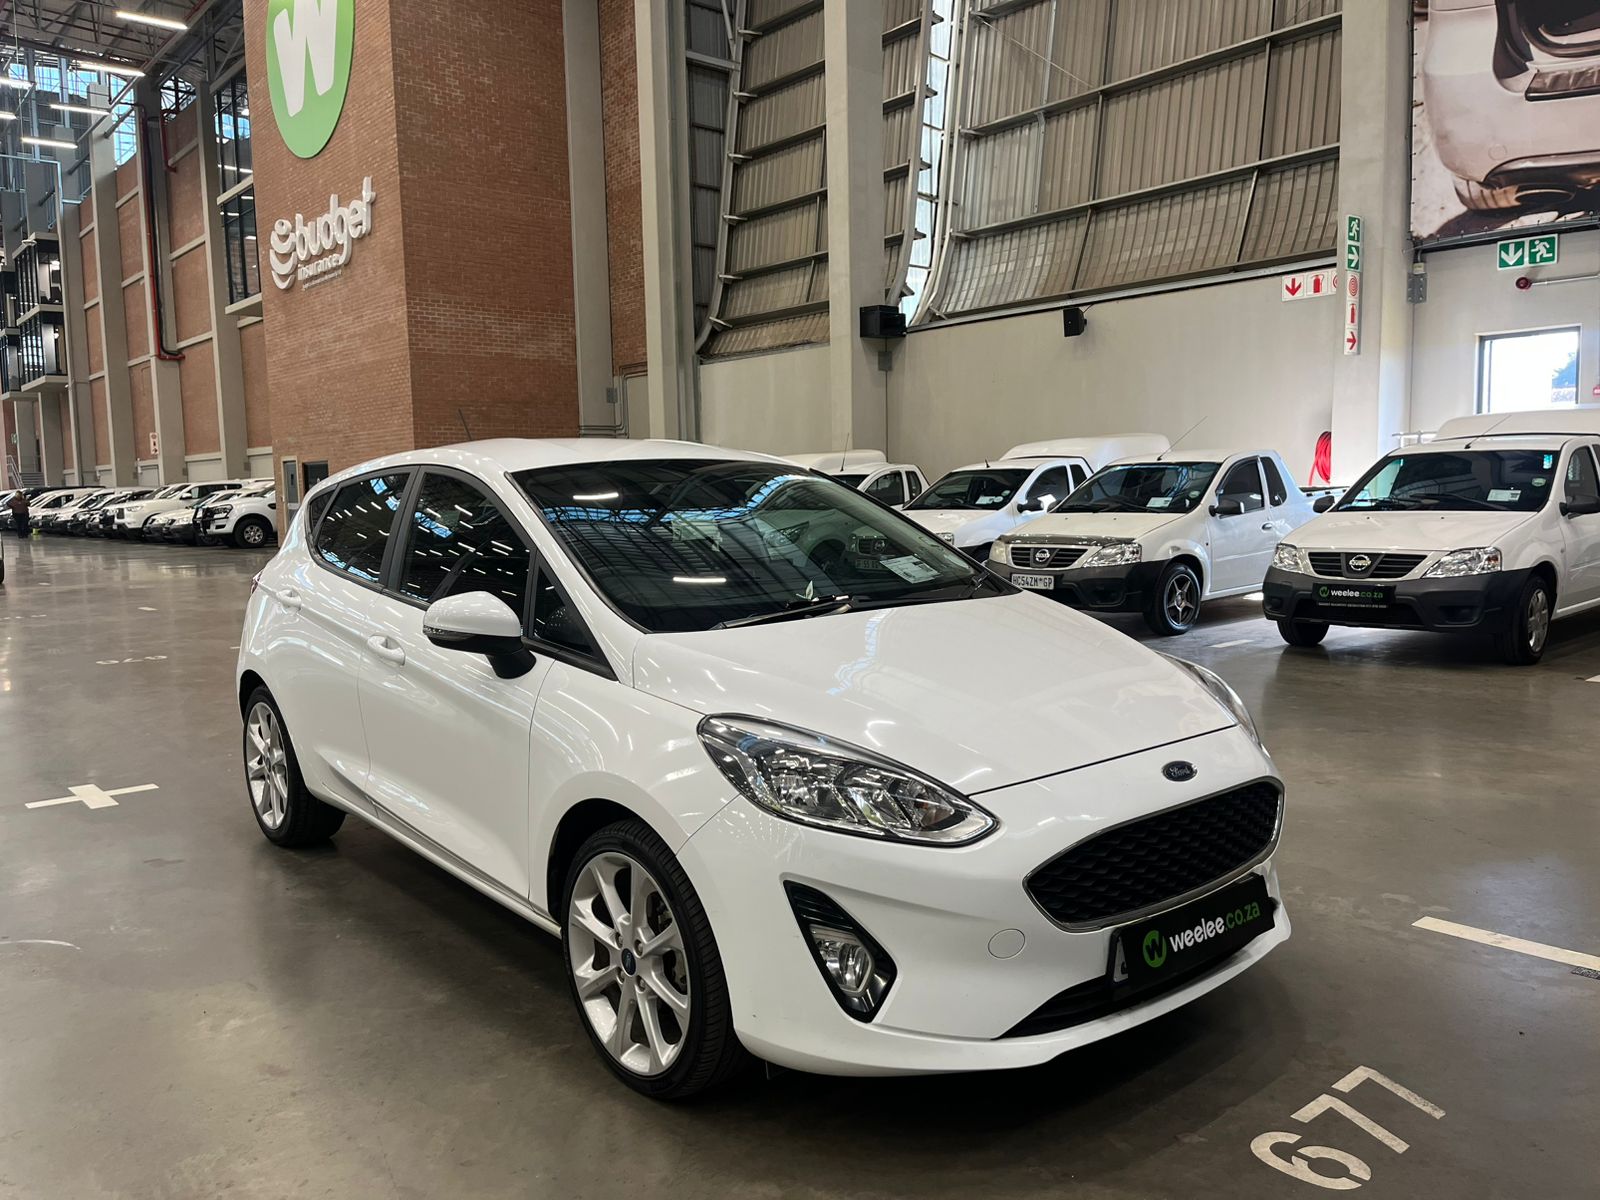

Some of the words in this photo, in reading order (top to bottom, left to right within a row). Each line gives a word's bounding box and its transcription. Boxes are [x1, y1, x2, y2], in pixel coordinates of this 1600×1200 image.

[295, 176, 376, 267] budget
[1043, 577, 1053, 588] GP
[1331, 589, 1384, 599] weelee.co.za
[1169, 901, 1261, 953] weelee.co.za
[1250, 1065, 1446, 1190] 677
